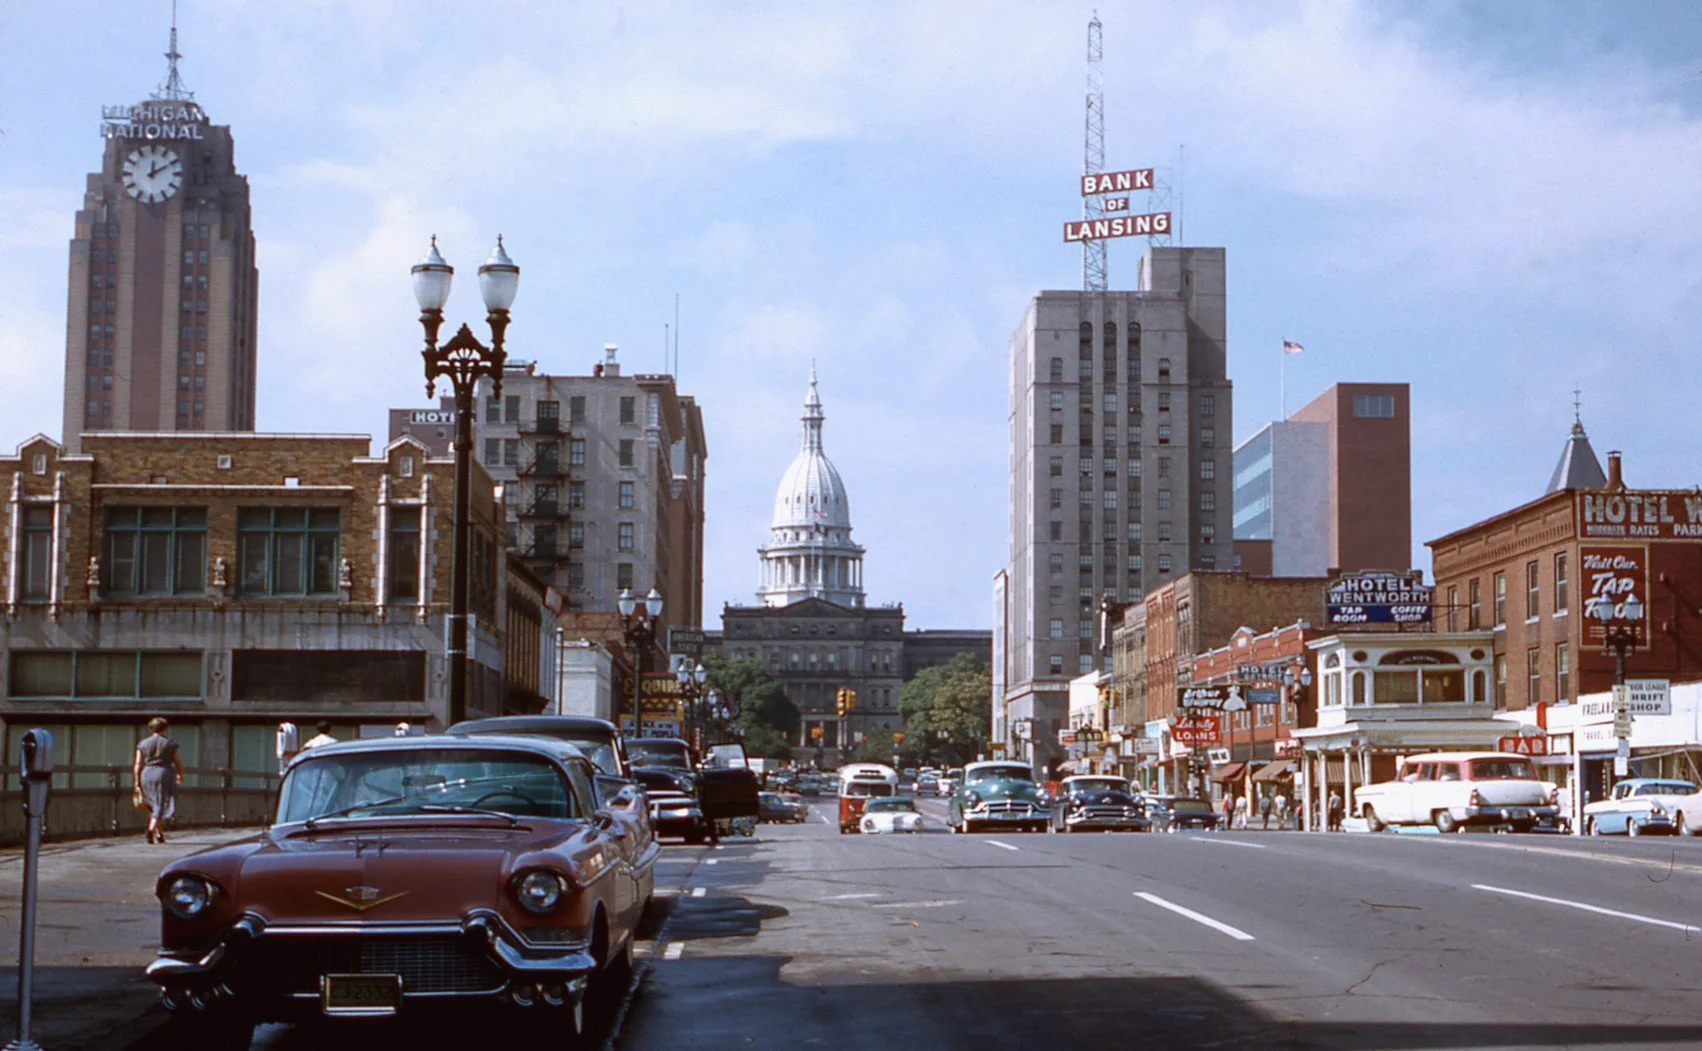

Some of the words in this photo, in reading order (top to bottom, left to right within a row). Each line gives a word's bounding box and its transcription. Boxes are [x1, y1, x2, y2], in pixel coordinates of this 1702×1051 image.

[100, 123, 203, 139] NATIONAL
[1083, 170, 1150, 193] BANK
[1107, 199, 1125, 210] OF
[1066, 214, 1168, 240] LANSING
[1584, 494, 1674, 523] HOTEL
[1586, 525, 1625, 536] MODERATE
[1629, 525, 1660, 536] RATES
[1347, 579, 1410, 591] HOTEL
[1591, 571, 1635, 594] TAP
[1329, 592, 1430, 604] WENTWORTH
[1390, 605, 1428, 614] COFFEE
[1332, 614, 1367, 622] ROOM
[1394, 613, 1422, 622] SHOP
[1241, 665, 1284, 674] HOTEL
[1630, 693, 1664, 701] HRIFT
